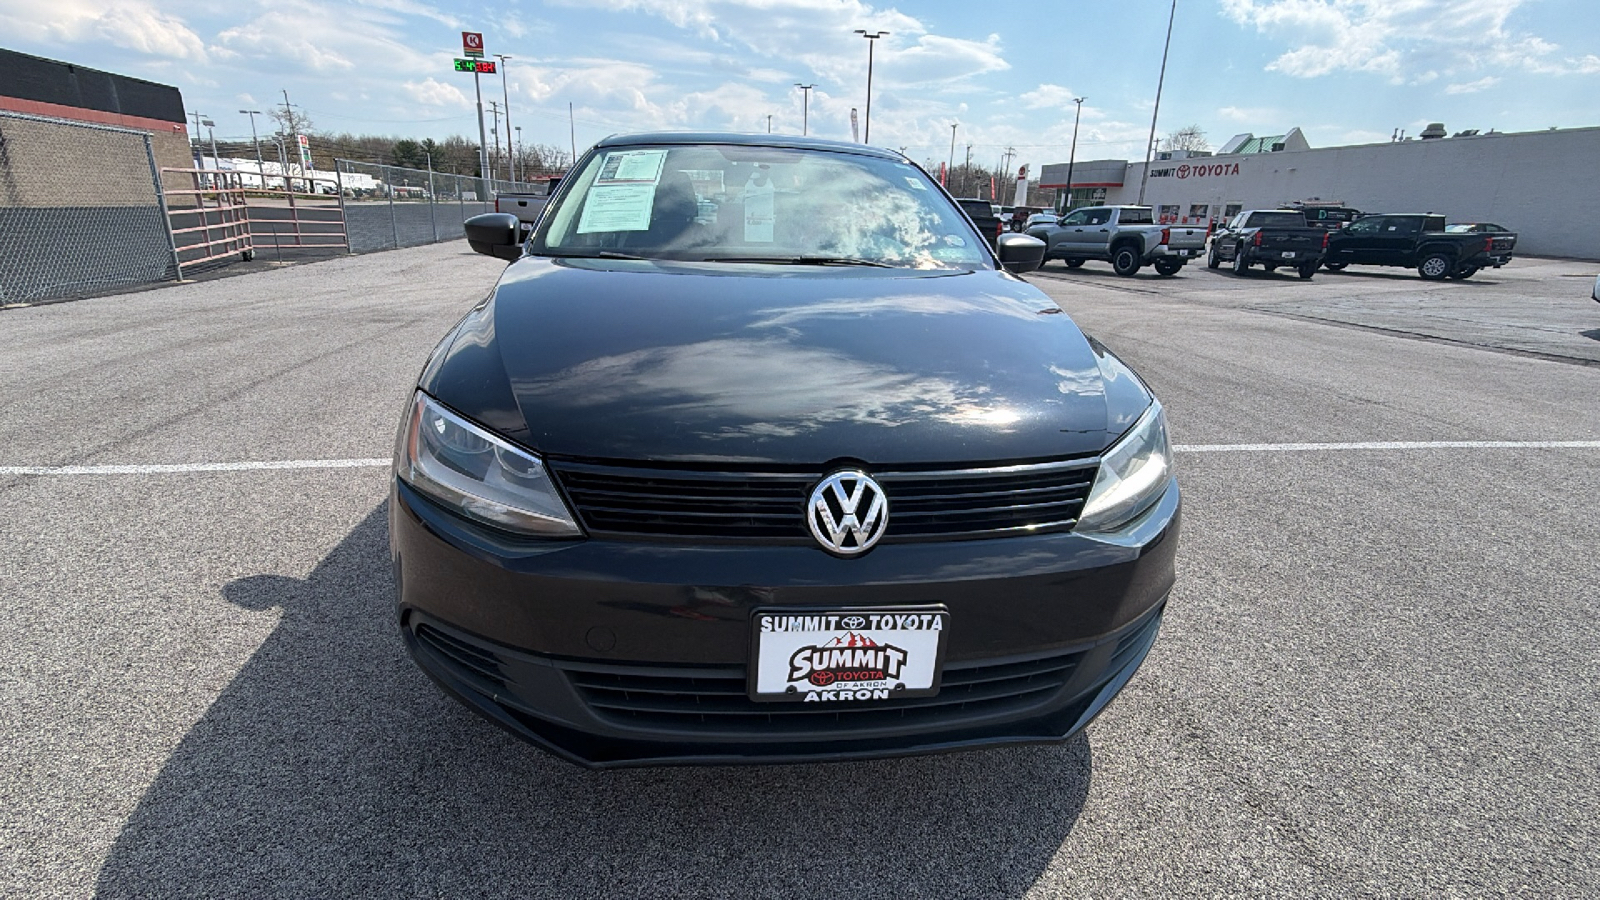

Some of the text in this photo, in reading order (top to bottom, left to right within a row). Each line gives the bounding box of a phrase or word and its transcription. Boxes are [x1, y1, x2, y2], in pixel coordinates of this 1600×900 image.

[468, 35, 479, 46] K
[1149, 163, 1240, 178] SUMMIT TOYOTA
[808, 471, 888, 553] VW
[760, 614, 943, 633] SUMMIT TOYOTA
[790, 647, 905, 680] SUMMIT
[836, 670, 884, 681] TOYOTA
[803, 689, 889, 702] AKRON
